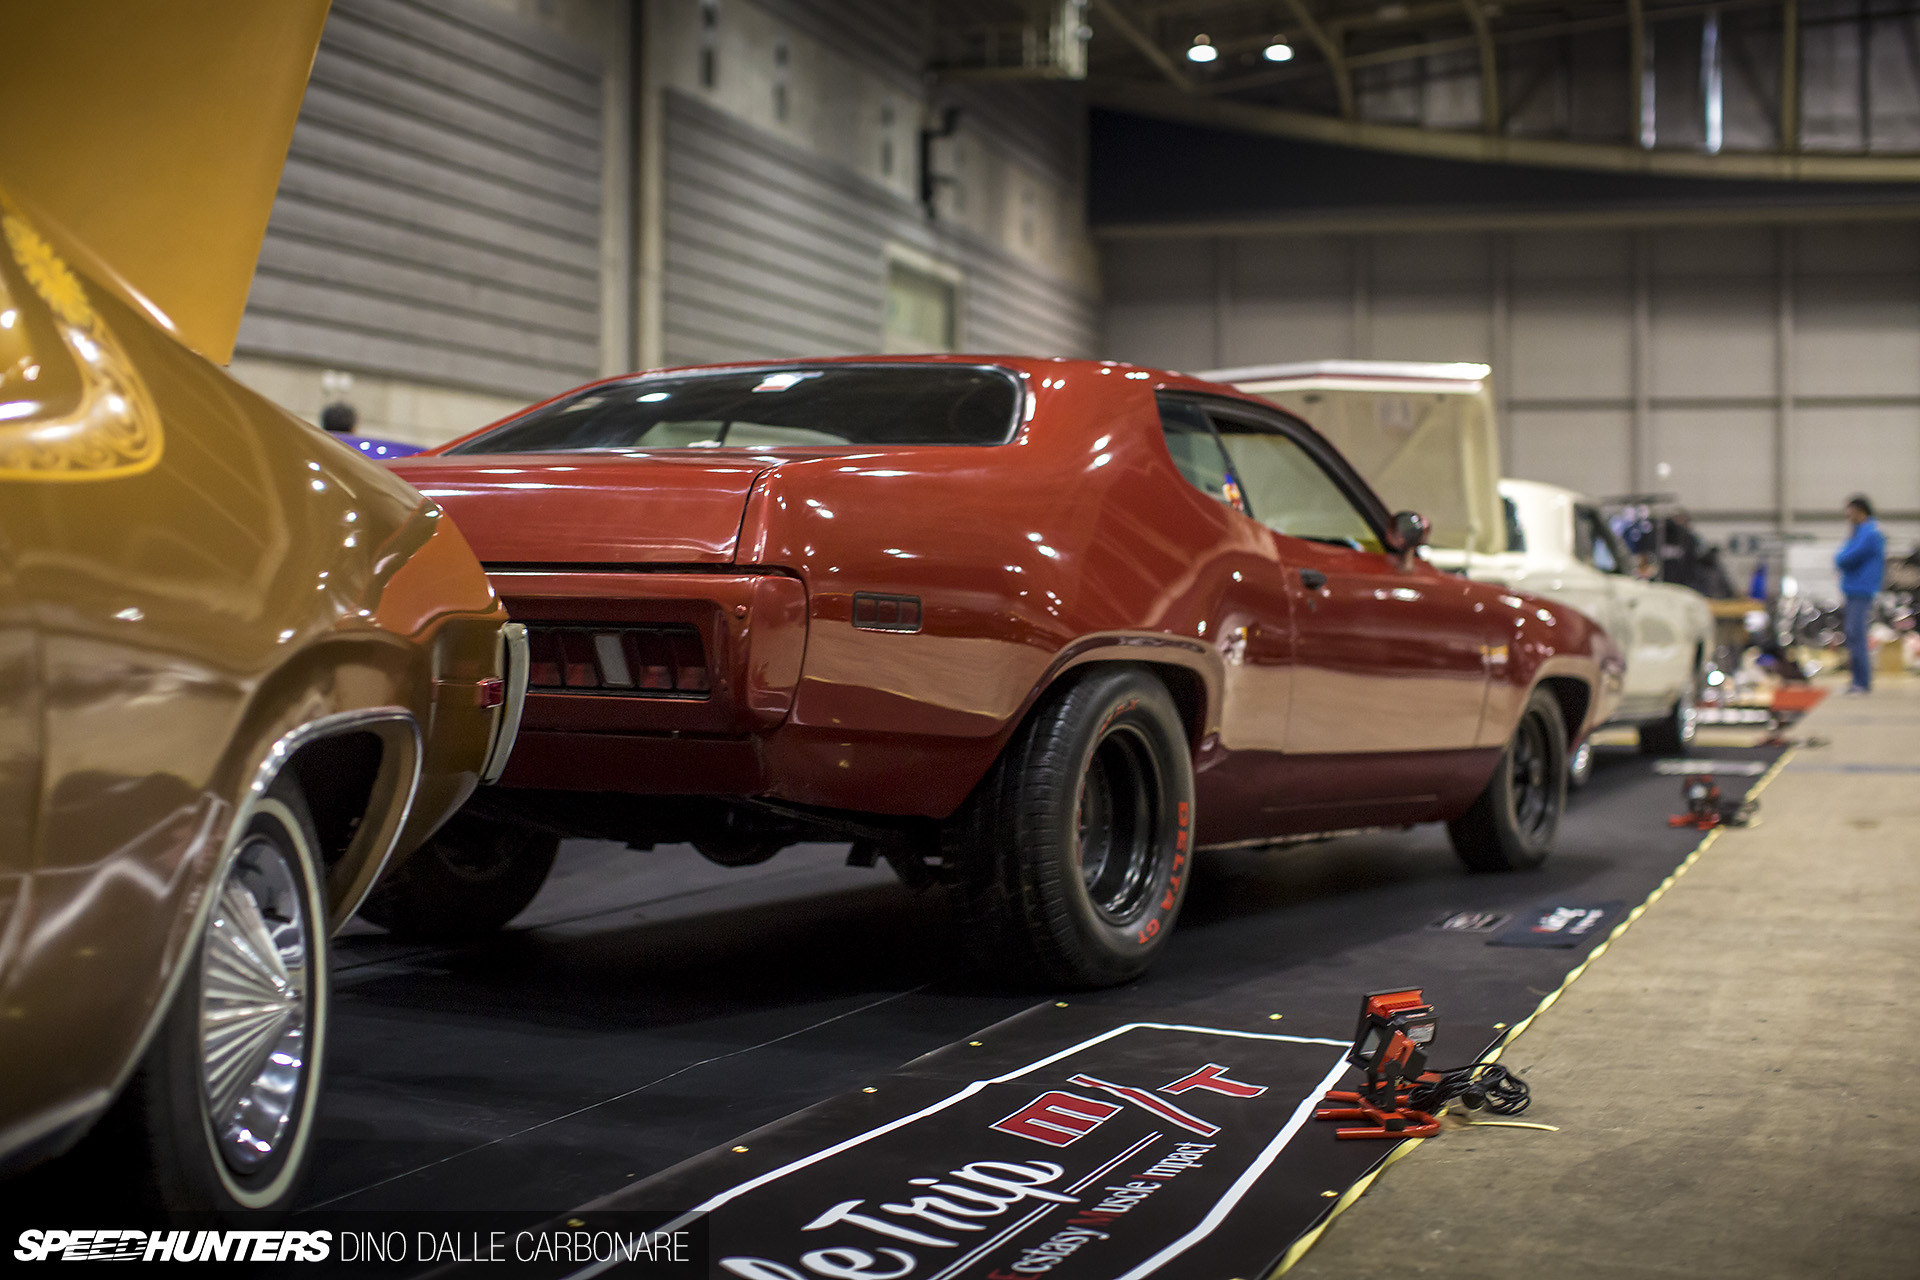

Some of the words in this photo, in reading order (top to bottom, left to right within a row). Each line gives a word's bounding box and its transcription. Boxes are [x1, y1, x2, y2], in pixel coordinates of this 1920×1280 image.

[1138, 918, 1161, 945] GT
[1066, 1181, 1163, 1226] Muscle
[1131, 1141, 1217, 1181] Impact
